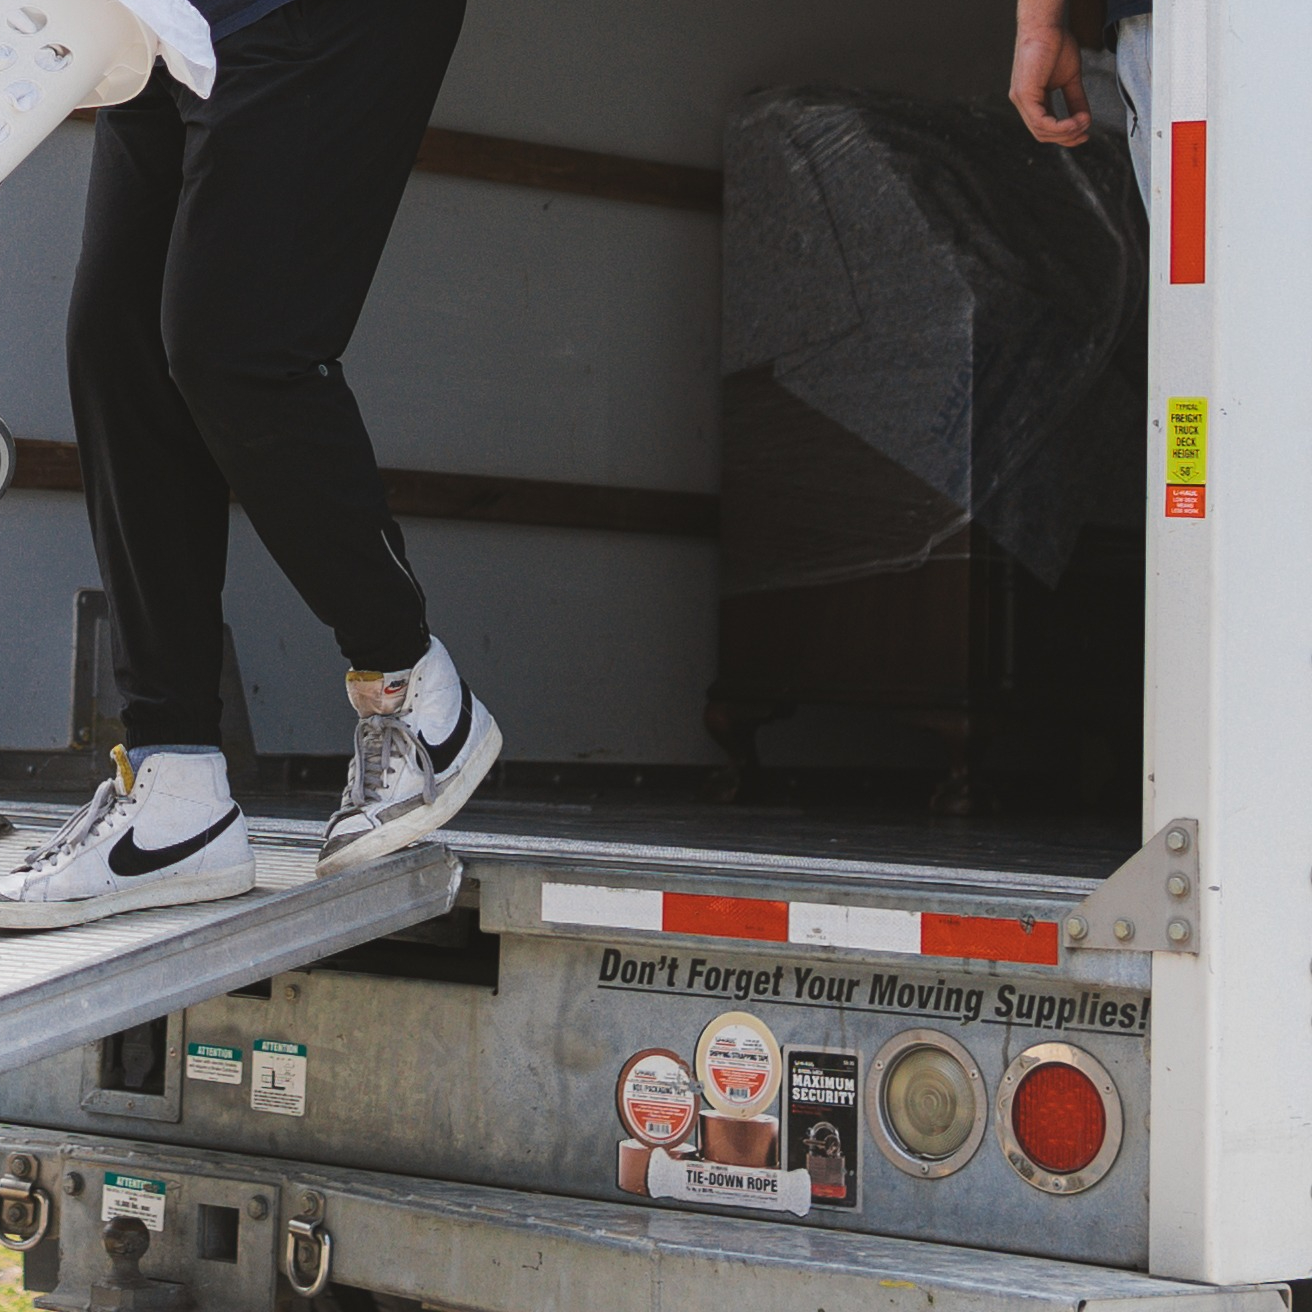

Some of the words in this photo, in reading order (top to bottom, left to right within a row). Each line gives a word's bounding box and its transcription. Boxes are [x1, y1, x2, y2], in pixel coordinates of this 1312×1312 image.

[1171, 413, 1202, 423] FREIGHT
[1174, 425, 1199, 435] TRUCK
[1176, 437, 1196, 447] DECK
[1172, 449, 1200, 459] HEIGHT
[599, 948, 680, 988] Don't
[688, 957, 785, 1002] Forget
[793, 966, 861, 1005] Your
[868, 972, 984, 1026] Moving
[994, 983, 1152, 1031] Supplies!
[197, 1045, 233, 1059] ATTENTION
[792, 1074, 855, 1091] MAXIMUM
[792, 1087, 856, 1105] SECURITY
[686, 1169, 744, 1188] TIE-DOWN
[747, 1176, 779, 1192] ROPE
